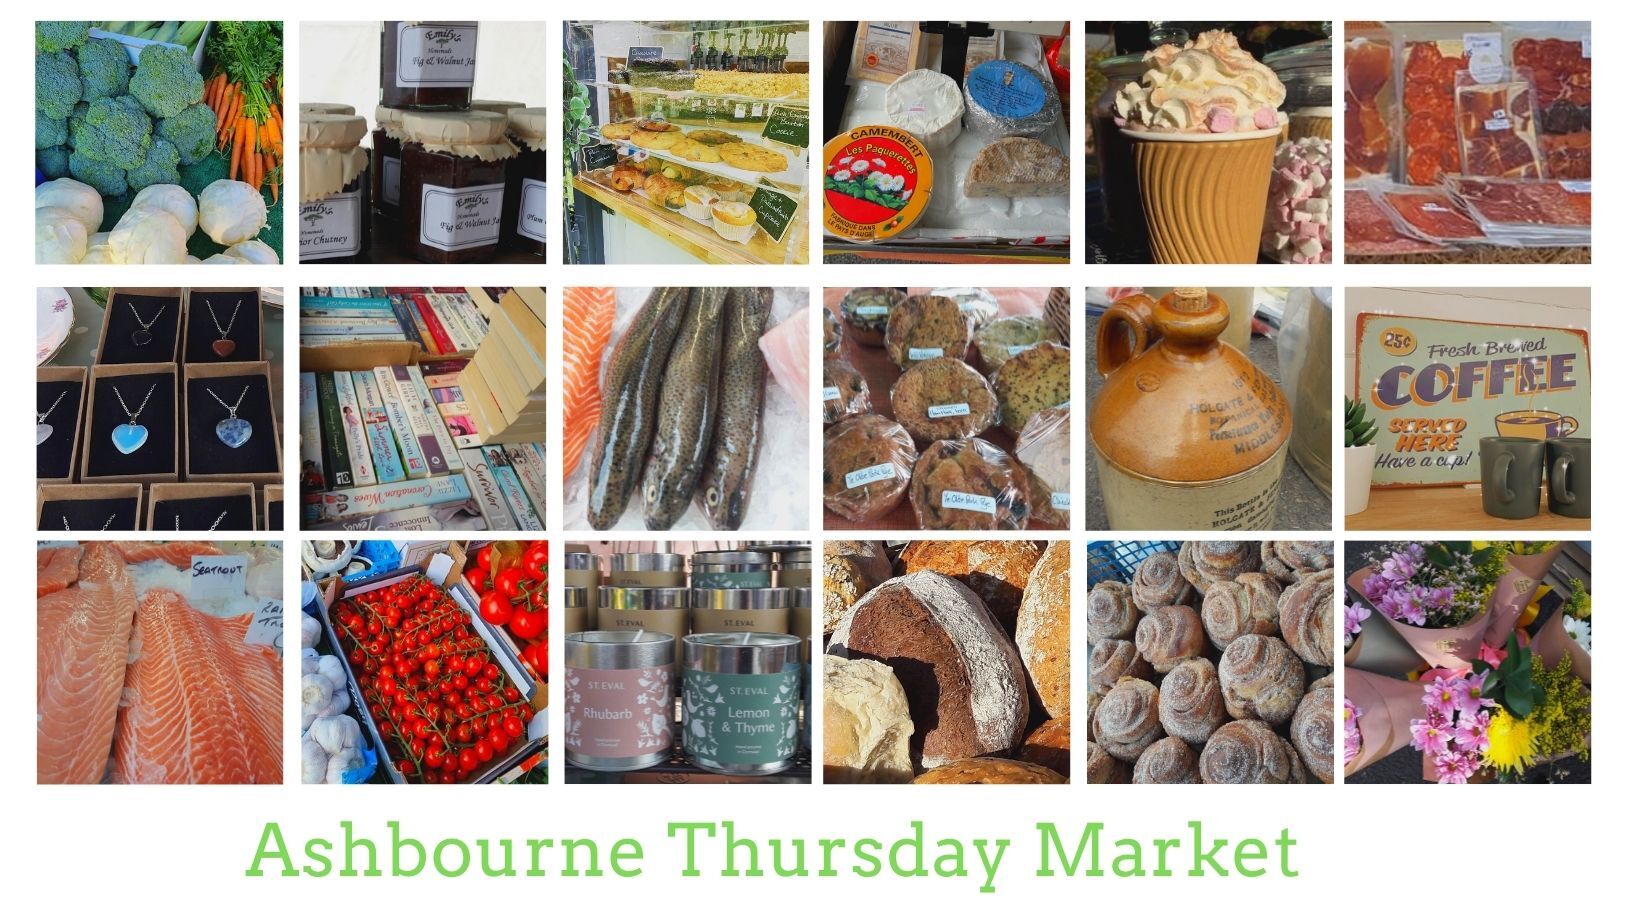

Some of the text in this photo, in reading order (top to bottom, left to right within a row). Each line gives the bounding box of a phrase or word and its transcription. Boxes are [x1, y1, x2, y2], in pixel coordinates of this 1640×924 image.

[425, 29, 461, 42] Emily's
[412, 56, 424, 67] Fig
[437, 56, 464, 65] Walnut
[850, 128, 924, 159] CAMEMBERT
[846, 147, 863, 157] Les
[456, 193, 489, 208] Emily's
[440, 221, 454, 233] Fig
[464, 217, 490, 228] Walnut
[835, 223, 849, 235] PAYS
[313, 235, 348, 245] Chutney
[1384, 332, 1412, 349] 25¢
[1428, 337, 1547, 359] Fresh Brewed
[383, 379, 394, 398] Gower
[1371, 353, 1577, 411] COFFEE
[366, 386, 375, 407] Morgan
[1189, 397, 1244, 413] HOLGATE
[390, 402, 413, 455] Bomber's Moon
[1388, 417, 1467, 434] SERVED
[1395, 434, 1462, 452] HERE
[1375, 451, 1473, 470] Have a cup!
[467, 462, 500, 510] Survivor
[354, 485, 433, 507] Coronation Wives
[1212, 505, 1256, 528] HOLGATE
[1214, 507, 1235, 518] This
[389, 516, 431, 528] Innocence
[583, 707, 633, 720] Rhubarb
[728, 708, 770, 719] Lemon
[722, 721, 775, 736] & Thyme
